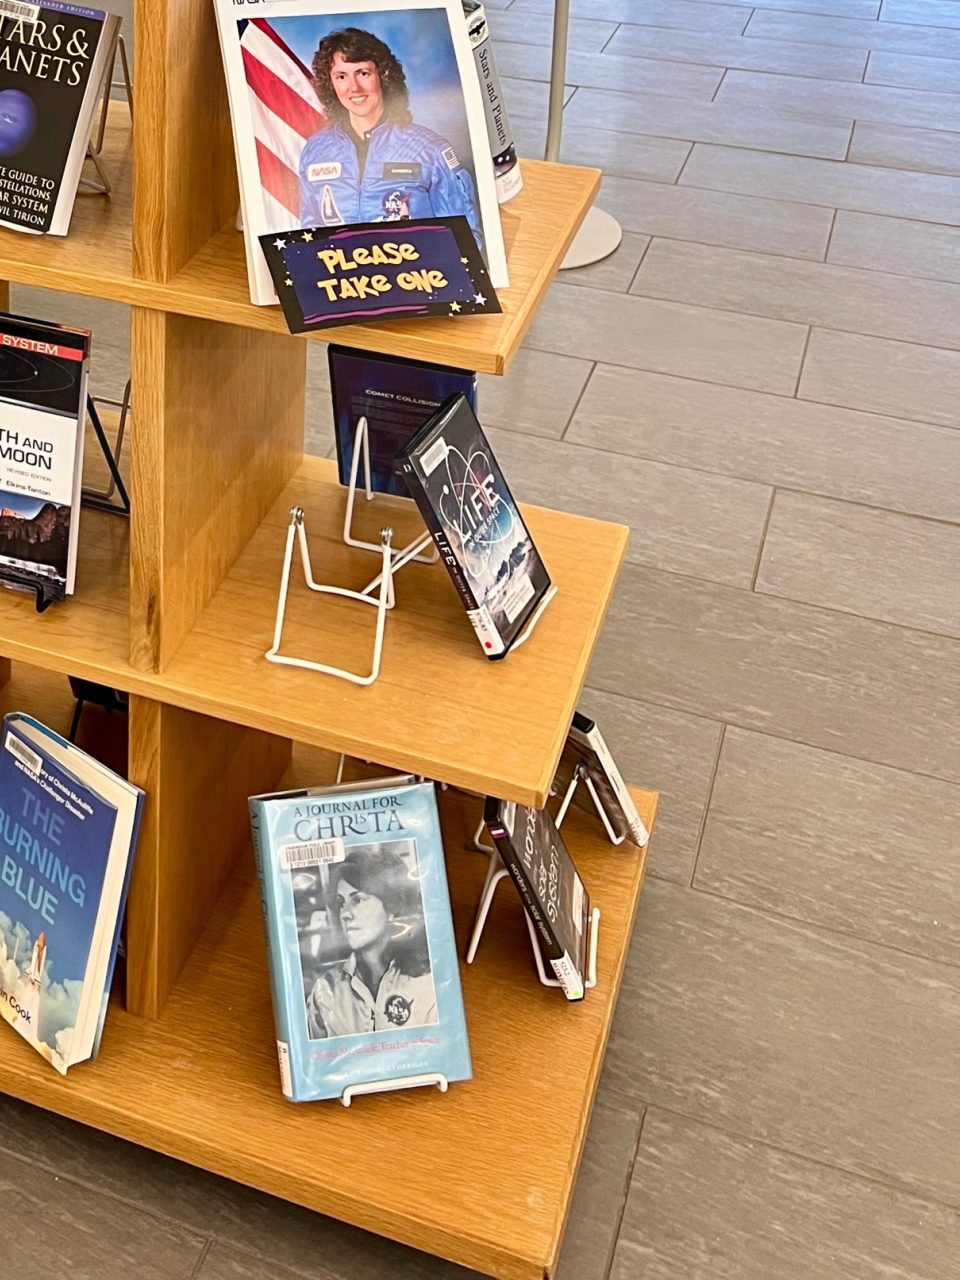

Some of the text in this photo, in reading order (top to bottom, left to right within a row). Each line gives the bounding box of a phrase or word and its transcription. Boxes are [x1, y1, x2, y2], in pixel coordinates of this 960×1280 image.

[66, 28, 90, 59] &
[479, 48, 507, 146] Stars and Planets
[8, 169, 38, 186] GUIDE
[41, 177, 55, 190] TO
[312, 166, 338, 177] NASA
[12, 194, 49, 214] SYSTEM
[13, 209, 45, 226] TIRION
[2, 335, 59, 356] SYSTEM
[365, 389, 395, 400] COMET
[22, 437, 54, 455] AND
[453, 473, 501, 546] LIFE
[434, 531, 457, 566] LIFE
[21, 786, 66, 847] THE
[294, 795, 403, 818] A JOURNAL FOR
[293, 809, 407, 842] CHRISTA
[1, 854, 60, 926] BLUE
[8, 997, 32, 1025] Cook
